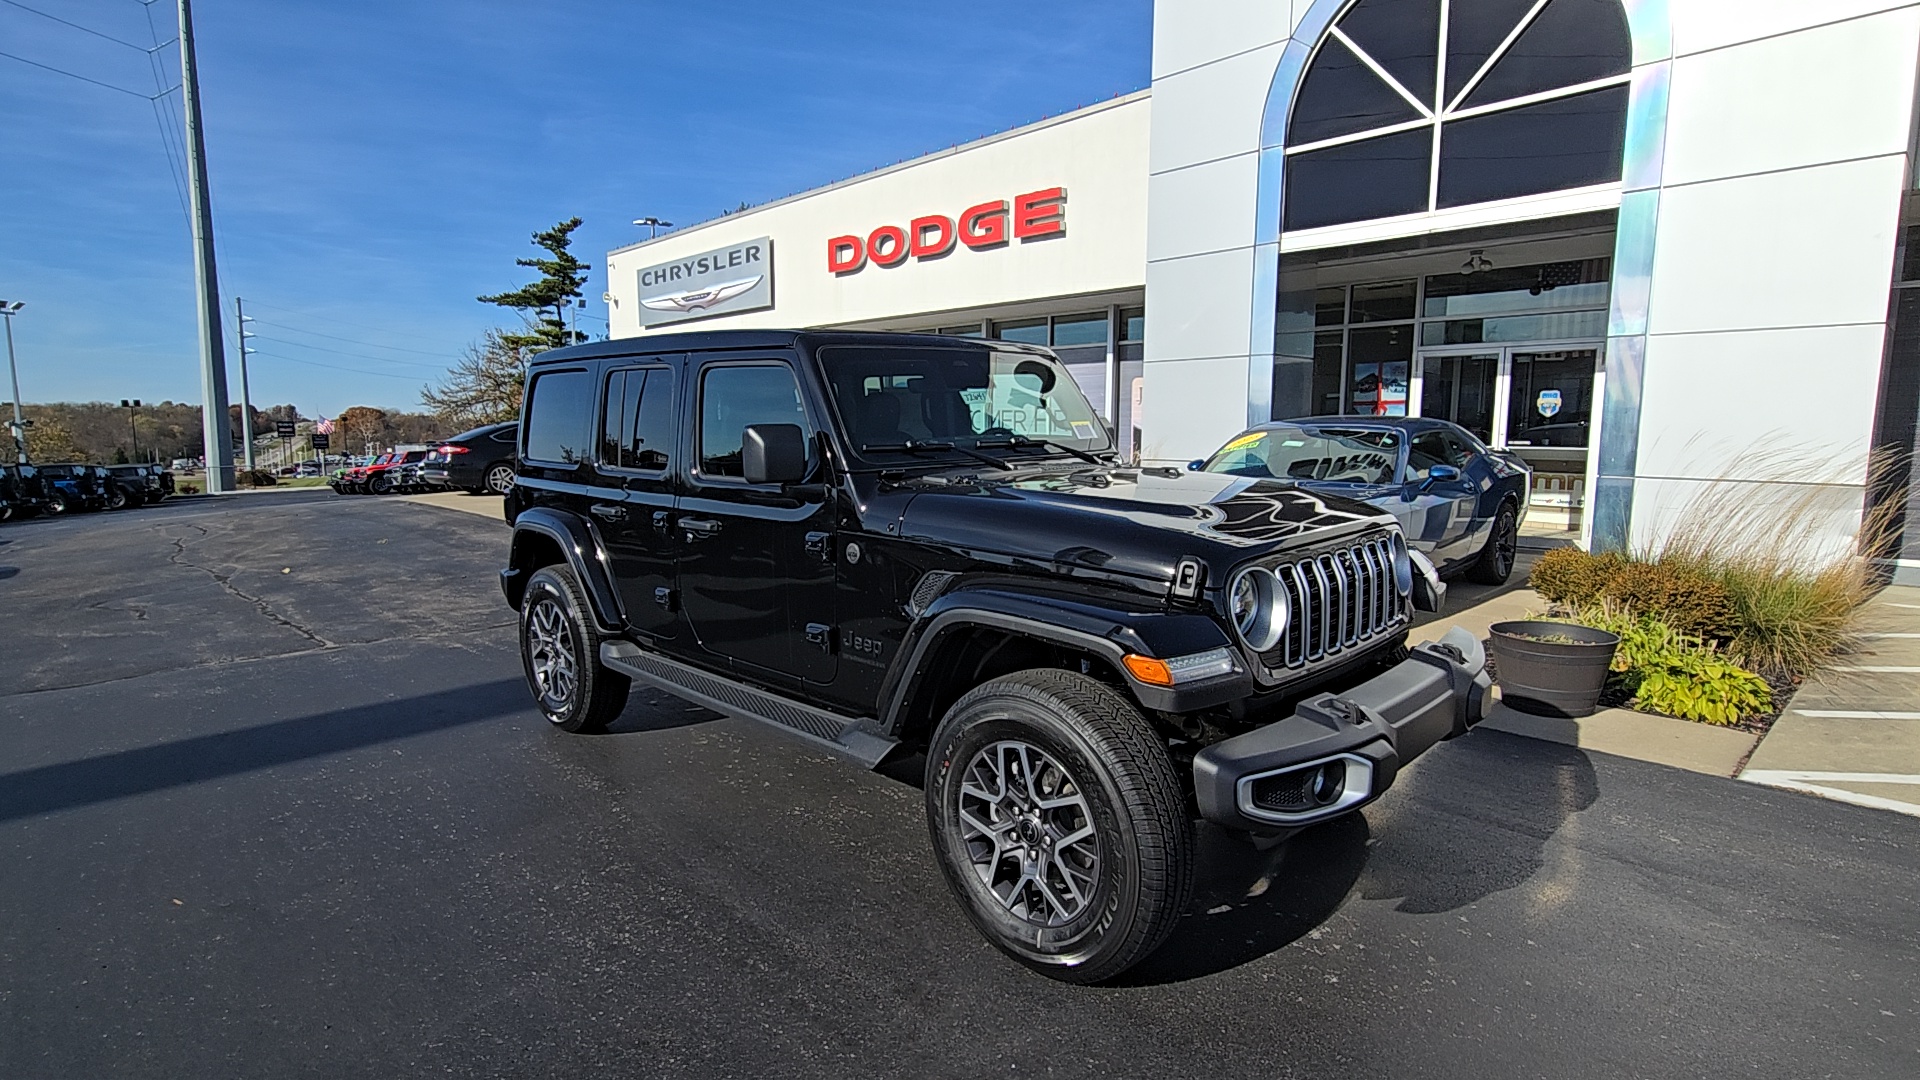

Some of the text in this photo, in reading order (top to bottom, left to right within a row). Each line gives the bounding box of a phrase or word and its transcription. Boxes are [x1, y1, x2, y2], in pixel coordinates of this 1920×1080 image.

[828, 187, 1065, 275] DODGE
[641, 245, 761, 287] CHRYSLER
[842, 630, 883, 658] Jeep
